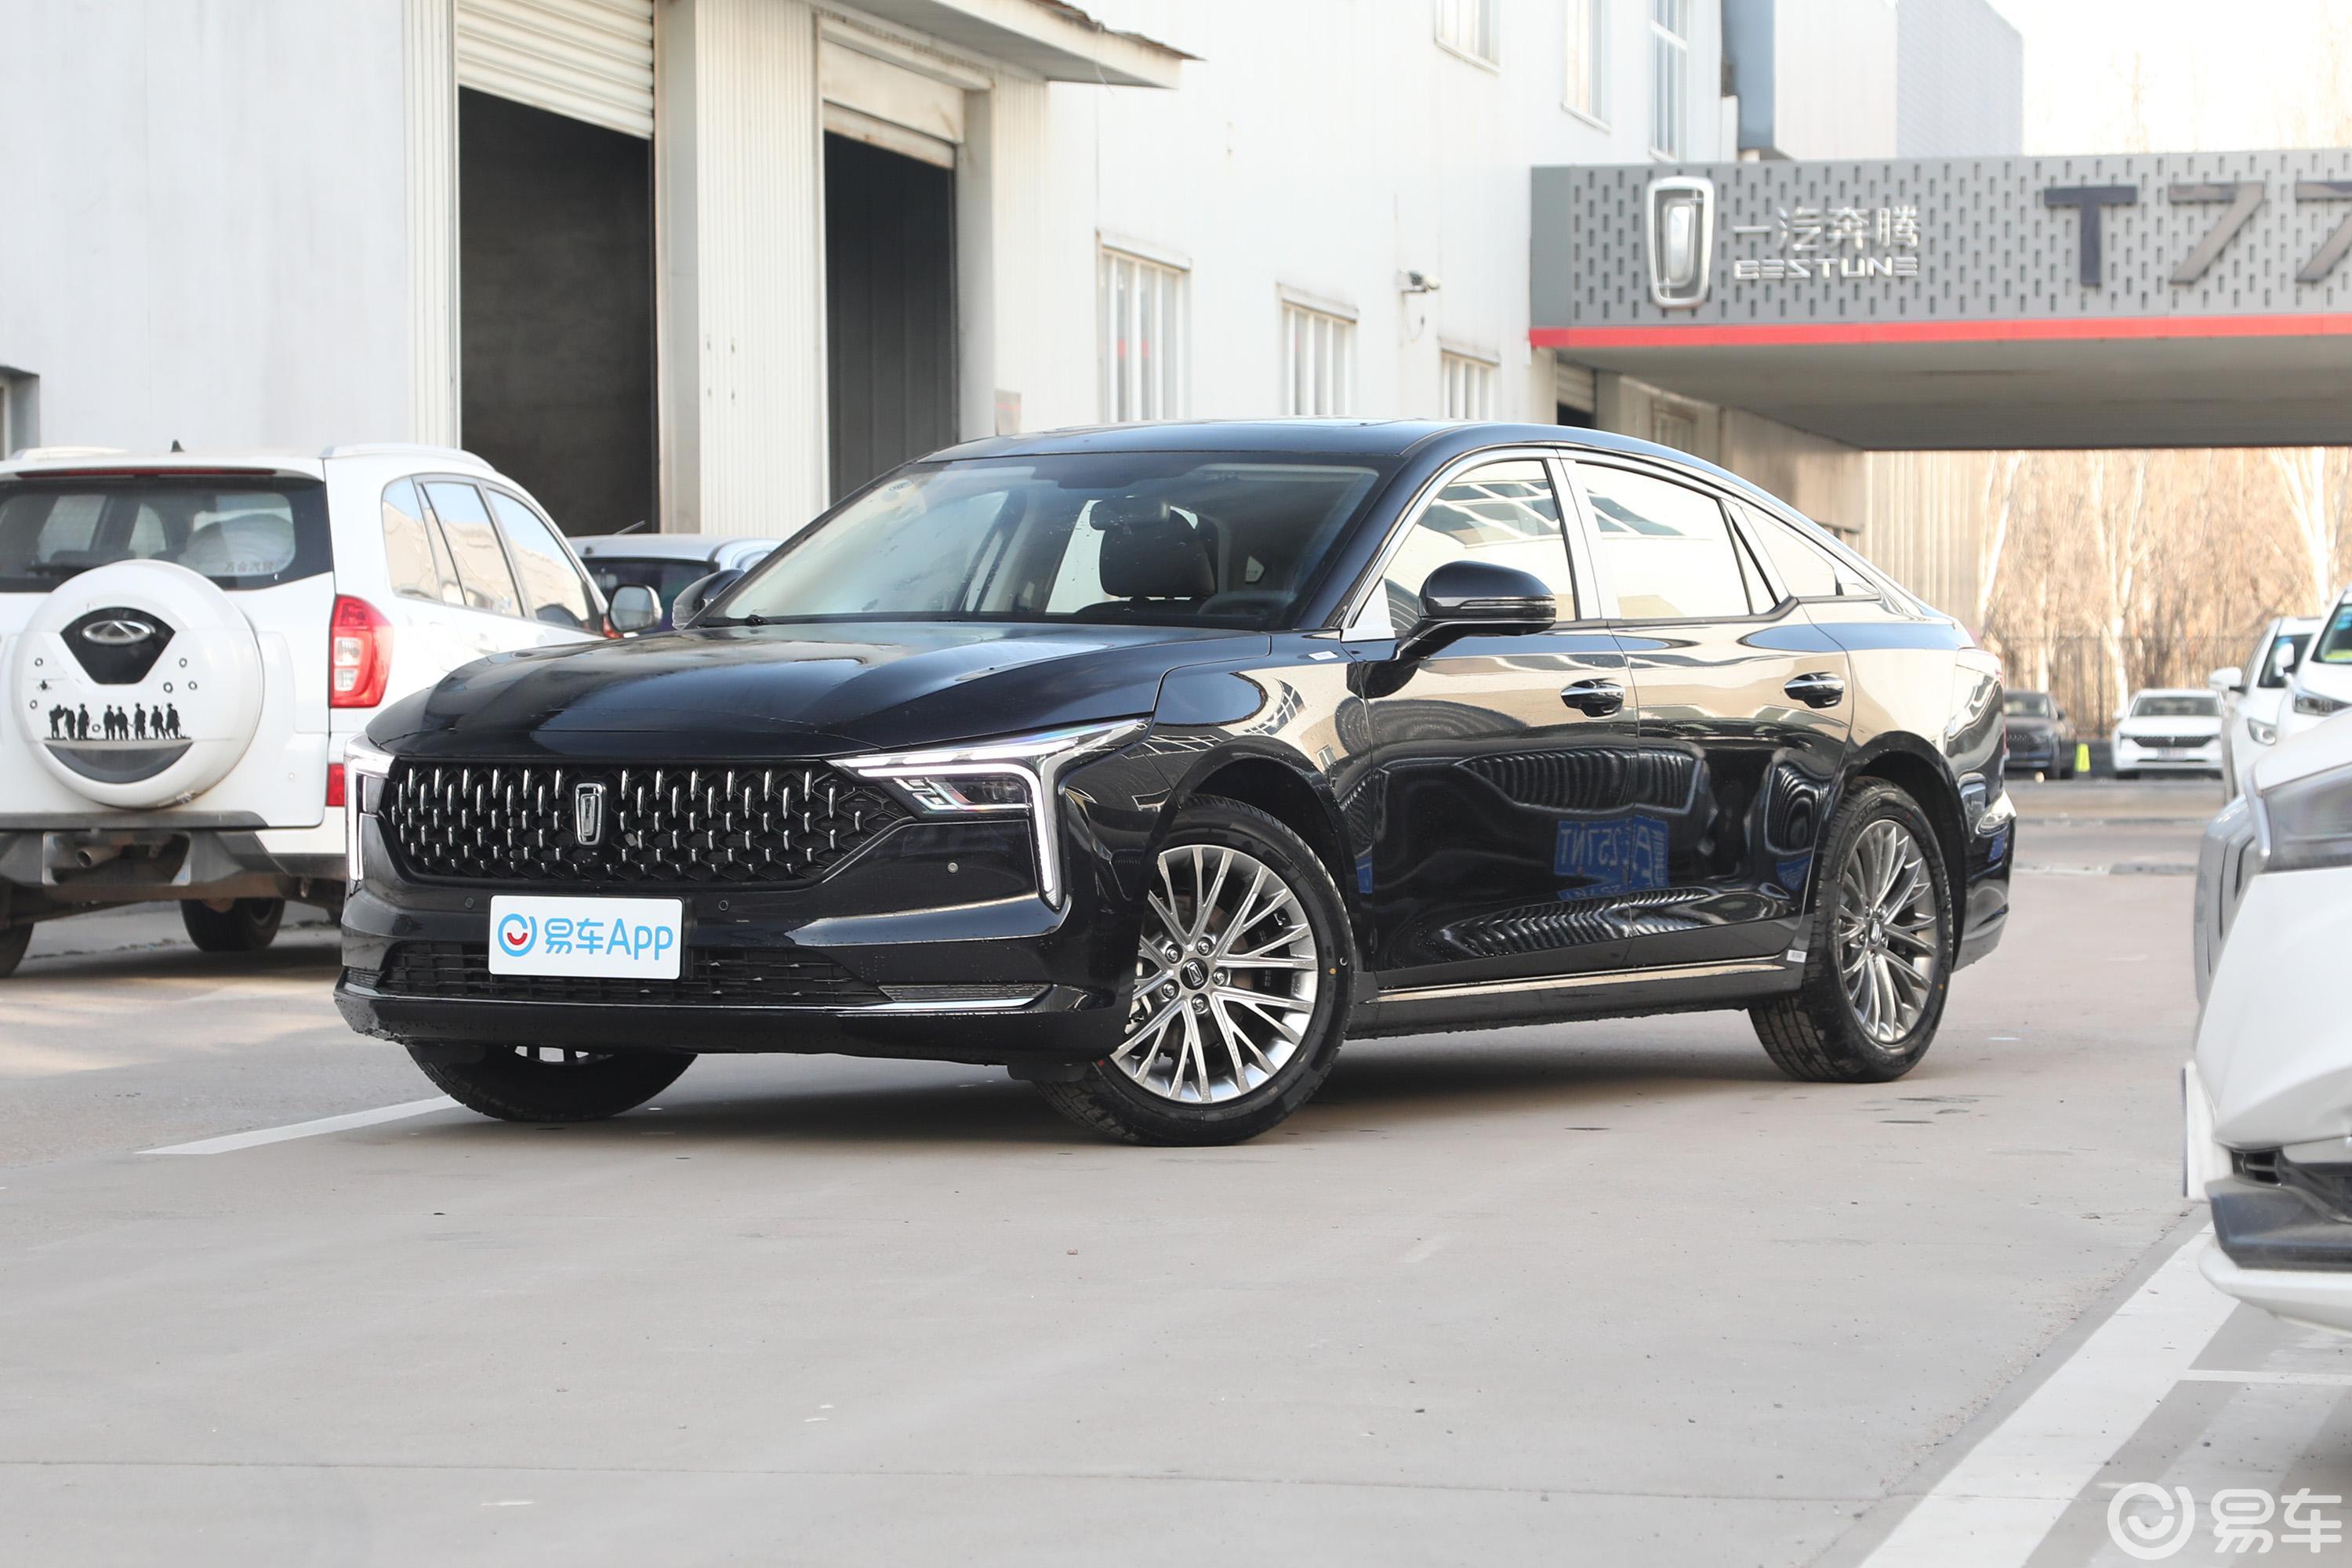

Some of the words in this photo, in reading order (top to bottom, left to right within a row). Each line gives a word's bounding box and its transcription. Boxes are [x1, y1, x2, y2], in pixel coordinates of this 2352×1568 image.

[1733, 205, 1919, 250] 一汽奔腾
[1733, 256, 1918, 280] BESTUNE
[544, 917, 673, 960] 易车App
